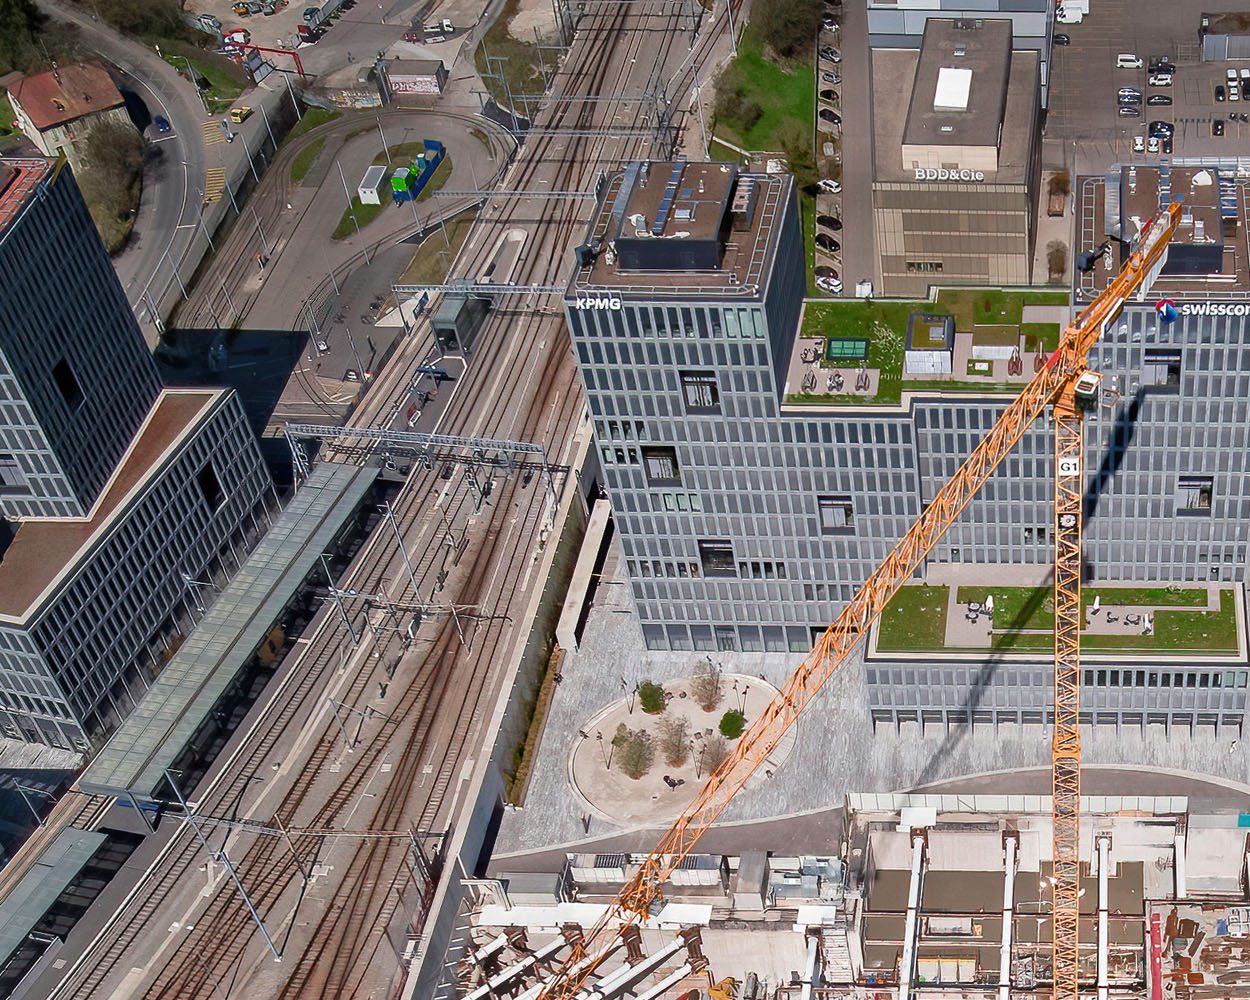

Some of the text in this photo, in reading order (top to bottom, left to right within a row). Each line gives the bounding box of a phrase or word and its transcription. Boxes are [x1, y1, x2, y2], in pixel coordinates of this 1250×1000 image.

[915, 168, 985, 181] BDD&Cie
[576, 297, 621, 310] KPMG
[1060, 462, 1077, 472] G1
